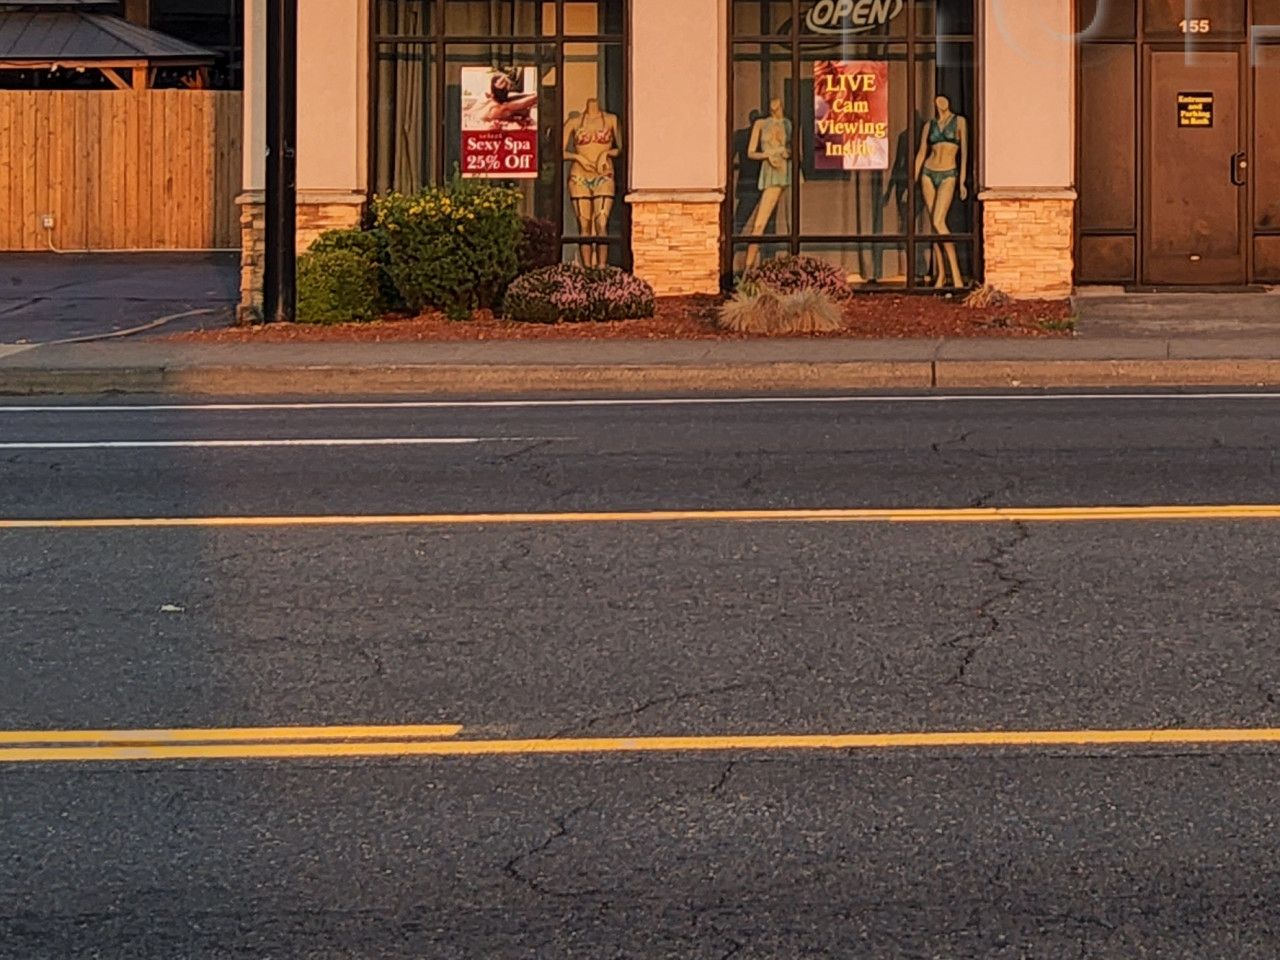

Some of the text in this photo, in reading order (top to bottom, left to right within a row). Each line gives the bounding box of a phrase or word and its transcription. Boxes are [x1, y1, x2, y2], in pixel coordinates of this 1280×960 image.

[1179, 19, 1210, 33] 155
[825, 74, 876, 92] LIVE
[832, 99, 869, 113] Cam
[1180, 110, 1211, 119] Parking
[818, 120, 886, 138] Viewing
[467, 137, 531, 154] Sexy Spa
[467, 155, 534, 170] 25% Off
